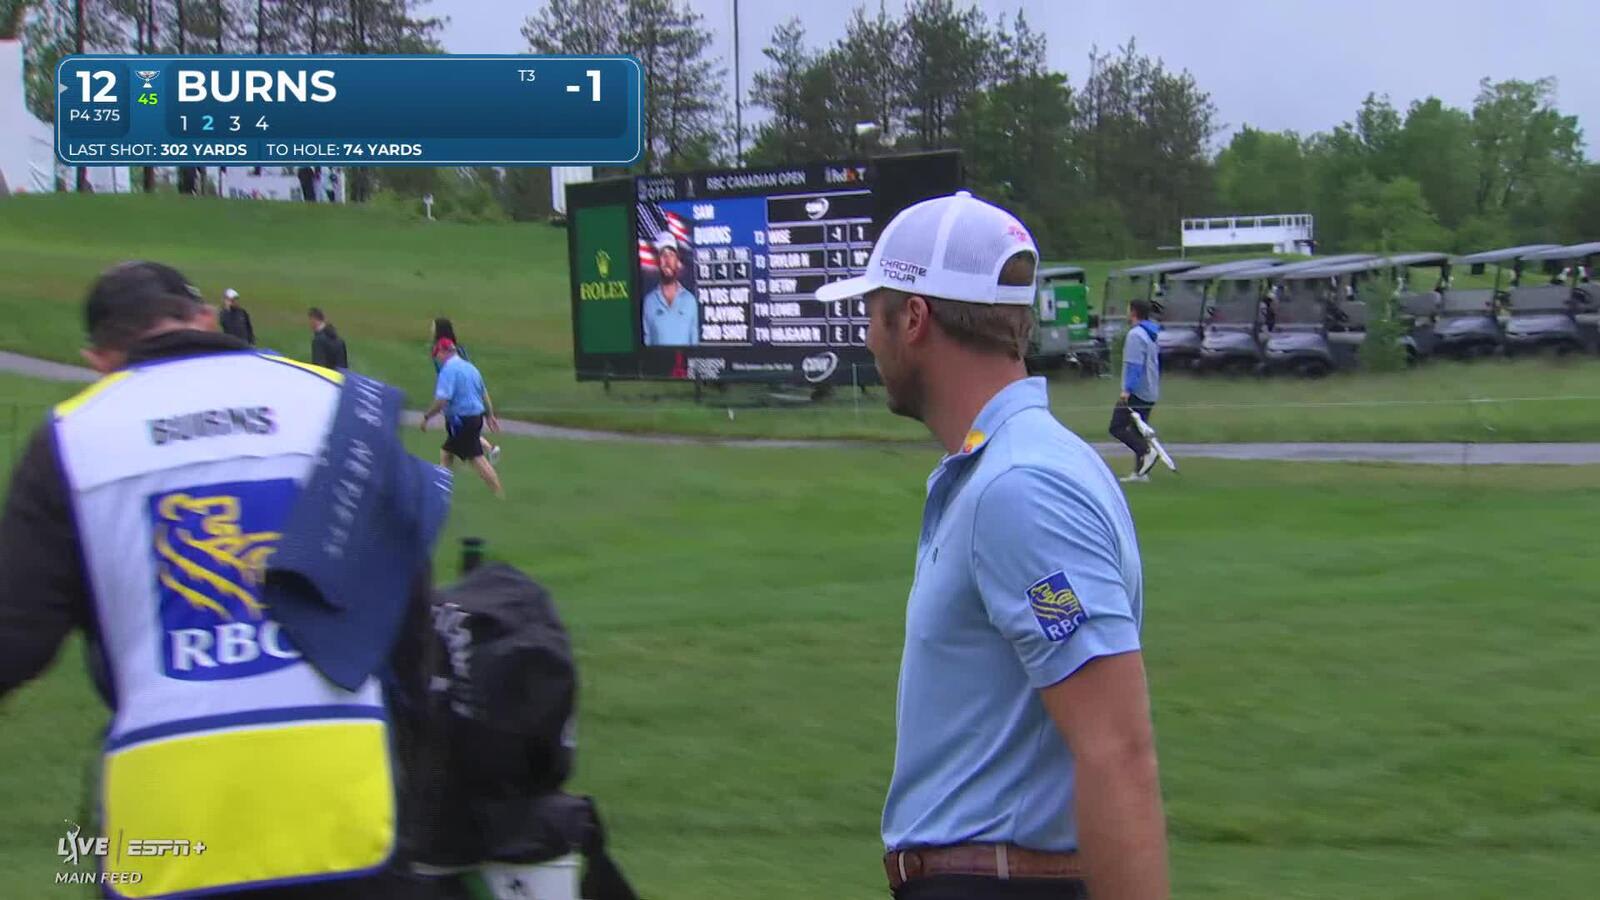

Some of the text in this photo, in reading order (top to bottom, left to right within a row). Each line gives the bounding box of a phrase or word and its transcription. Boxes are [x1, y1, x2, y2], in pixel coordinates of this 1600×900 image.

[706, 176, 726, 191] RBC
[727, 172, 777, 189] CANADIAN
[778, 170, 806, 186] OPEN
[880, 257, 928, 277] CHROME
[883, 269, 916, 285] TOUR
[580, 280, 629, 301] ROLEX
[148, 406, 278, 446] BURNS
[1046, 612, 1084, 641] RBC
